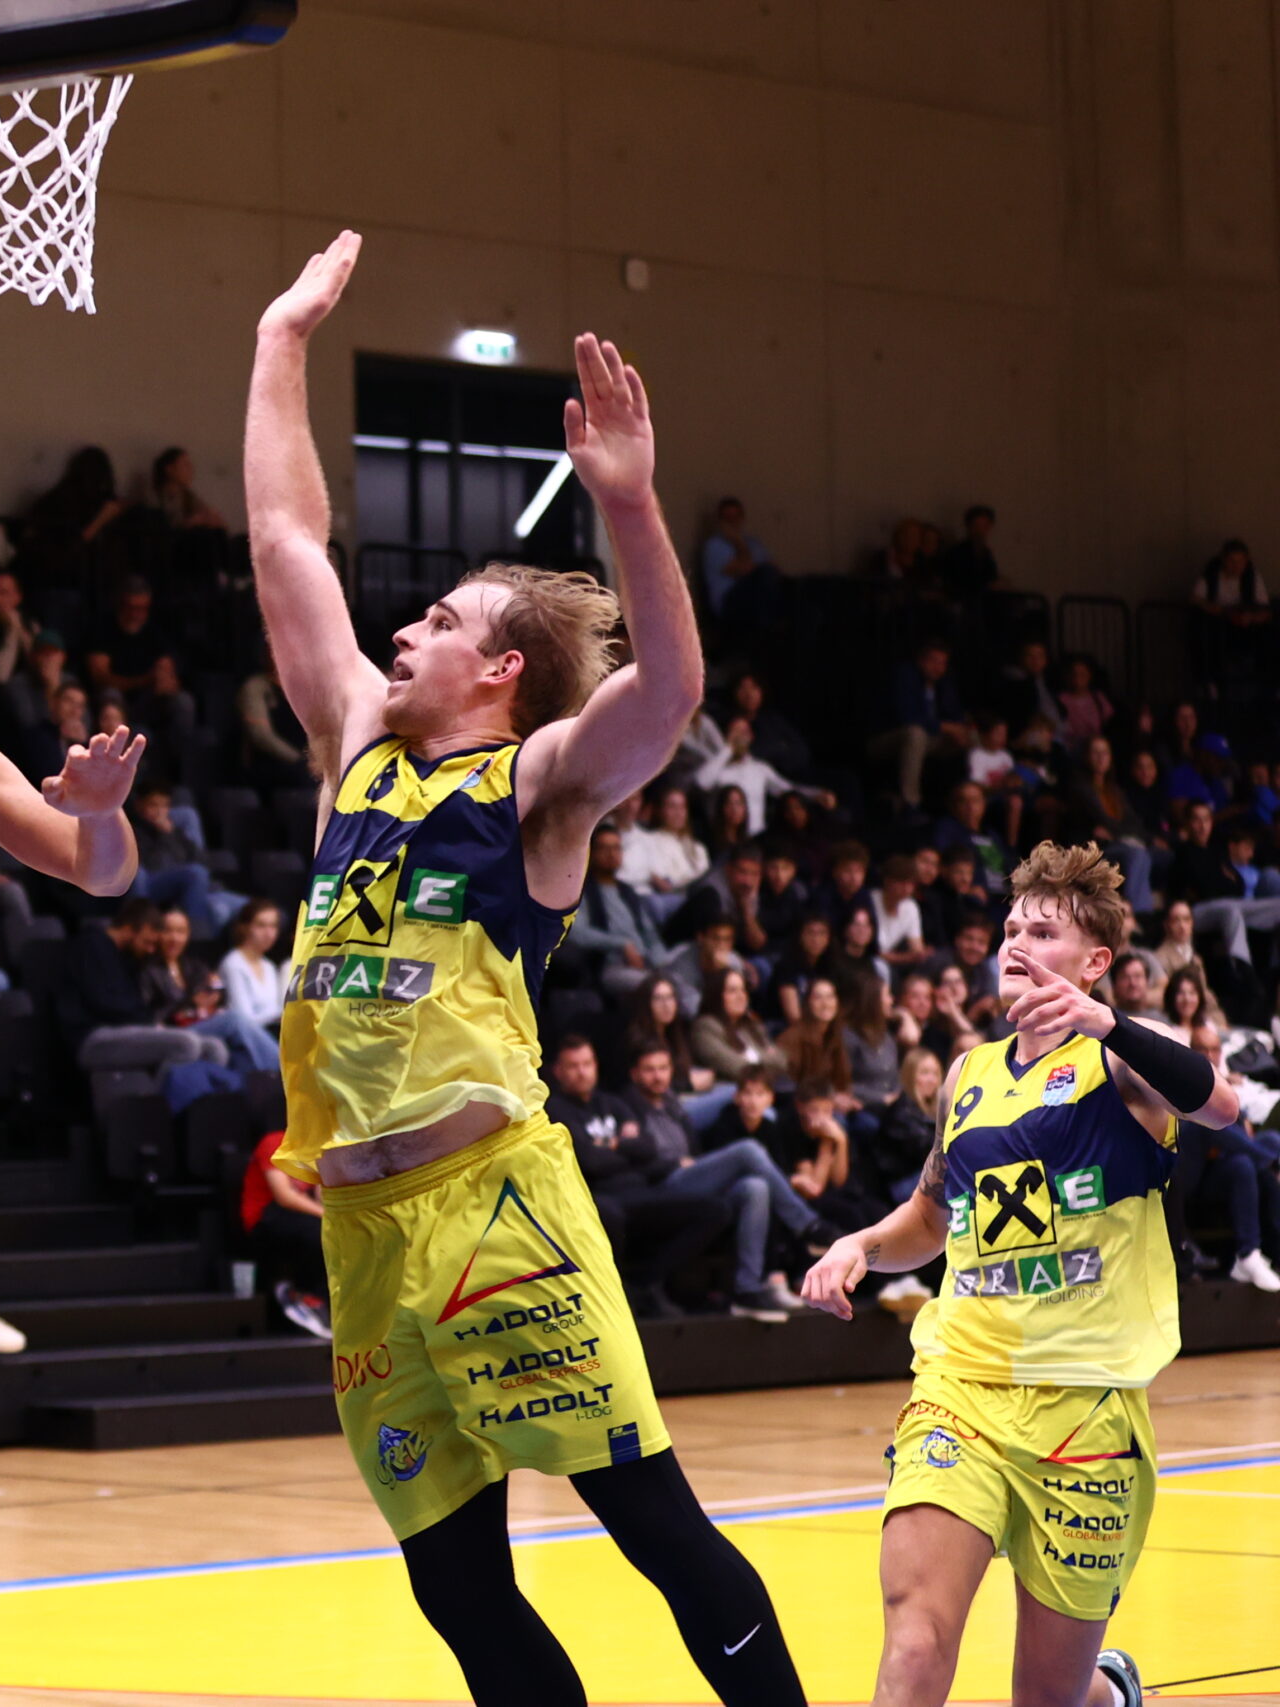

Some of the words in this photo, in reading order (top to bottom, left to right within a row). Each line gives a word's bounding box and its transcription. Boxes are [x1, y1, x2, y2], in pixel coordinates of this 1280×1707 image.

[413, 876, 457, 917] E
[952, 1085, 983, 1131] 9
[1063, 1173, 1099, 1210] E
[1038, 1285, 1105, 1306] HOLDING
[453, 1292, 583, 1341] HADOLT
[542, 1314, 586, 1334] GROUP
[467, 1336, 600, 1385] HADOLT
[499, 1370, 548, 1390] GLOBAL
[549, 1358, 601, 1380] EXPRESS
[479, 1382, 614, 1428] HADOLT
[576, 1404, 613, 1422] I-LOG
[1043, 1475, 1135, 1495] HADOLT
[1044, 1507, 1130, 1531] HADOLT
[1062, 1527, 1100, 1541] GLOBAL
[1043, 1541, 1125, 1570] HADOLT
